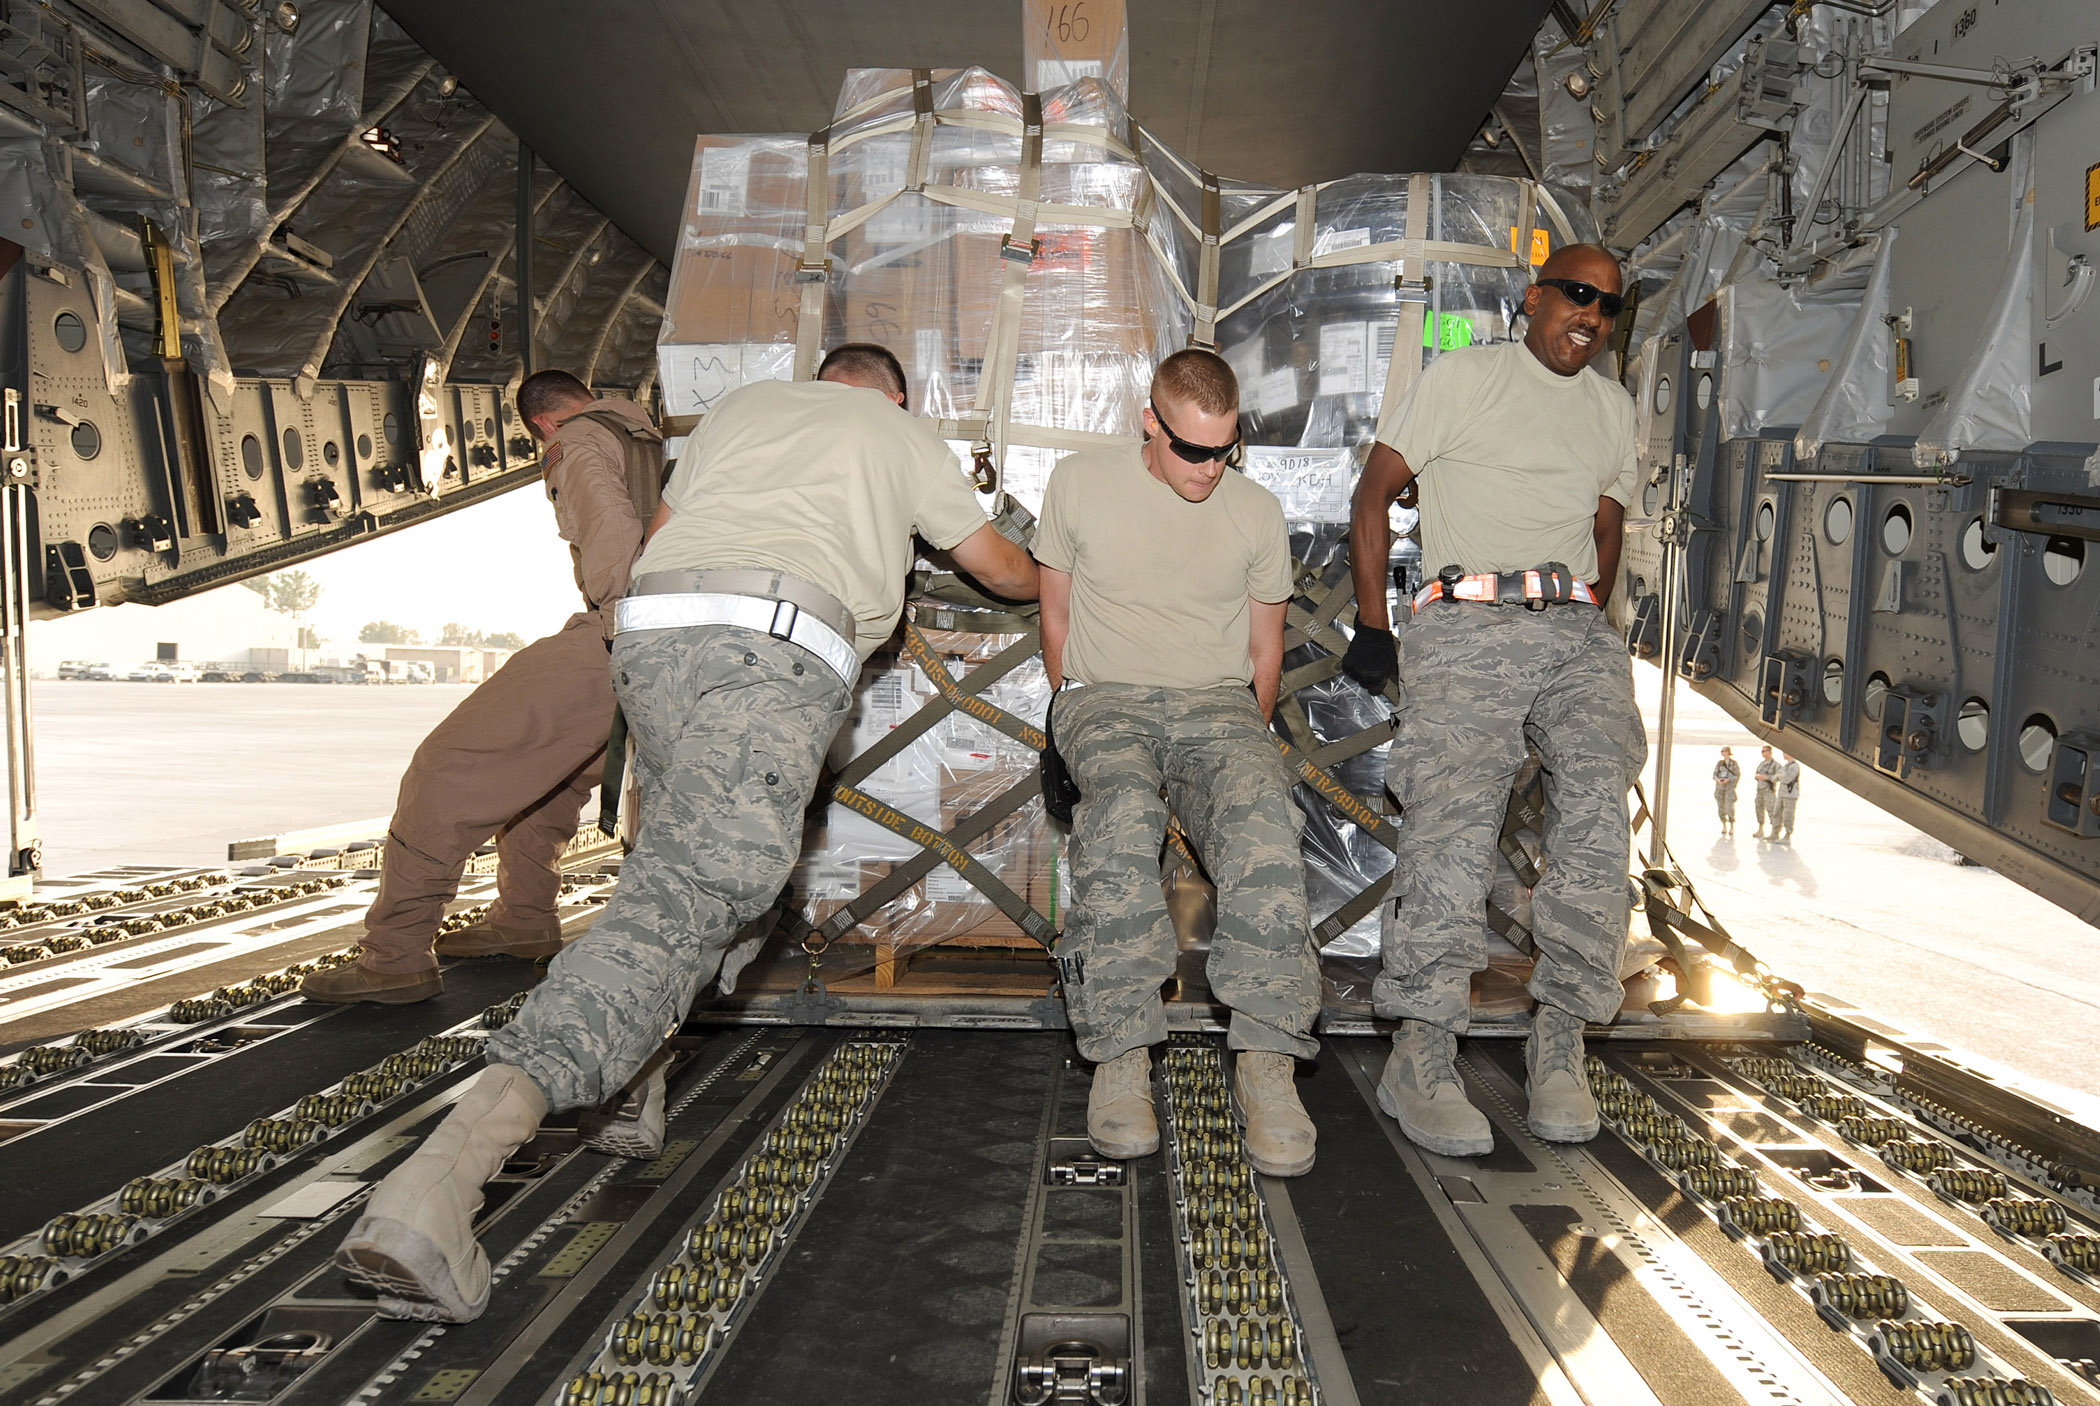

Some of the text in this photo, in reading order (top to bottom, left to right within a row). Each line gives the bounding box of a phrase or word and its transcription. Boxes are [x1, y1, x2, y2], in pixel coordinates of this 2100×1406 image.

[1044, 1, 1090, 48] 166
[1954, 8, 1977, 38] 1360
[2039, 342, 2063, 377] L
[71, 396, 89, 408] 1420
[833, 784, 970, 872] OUTSIDE BOTTOM
